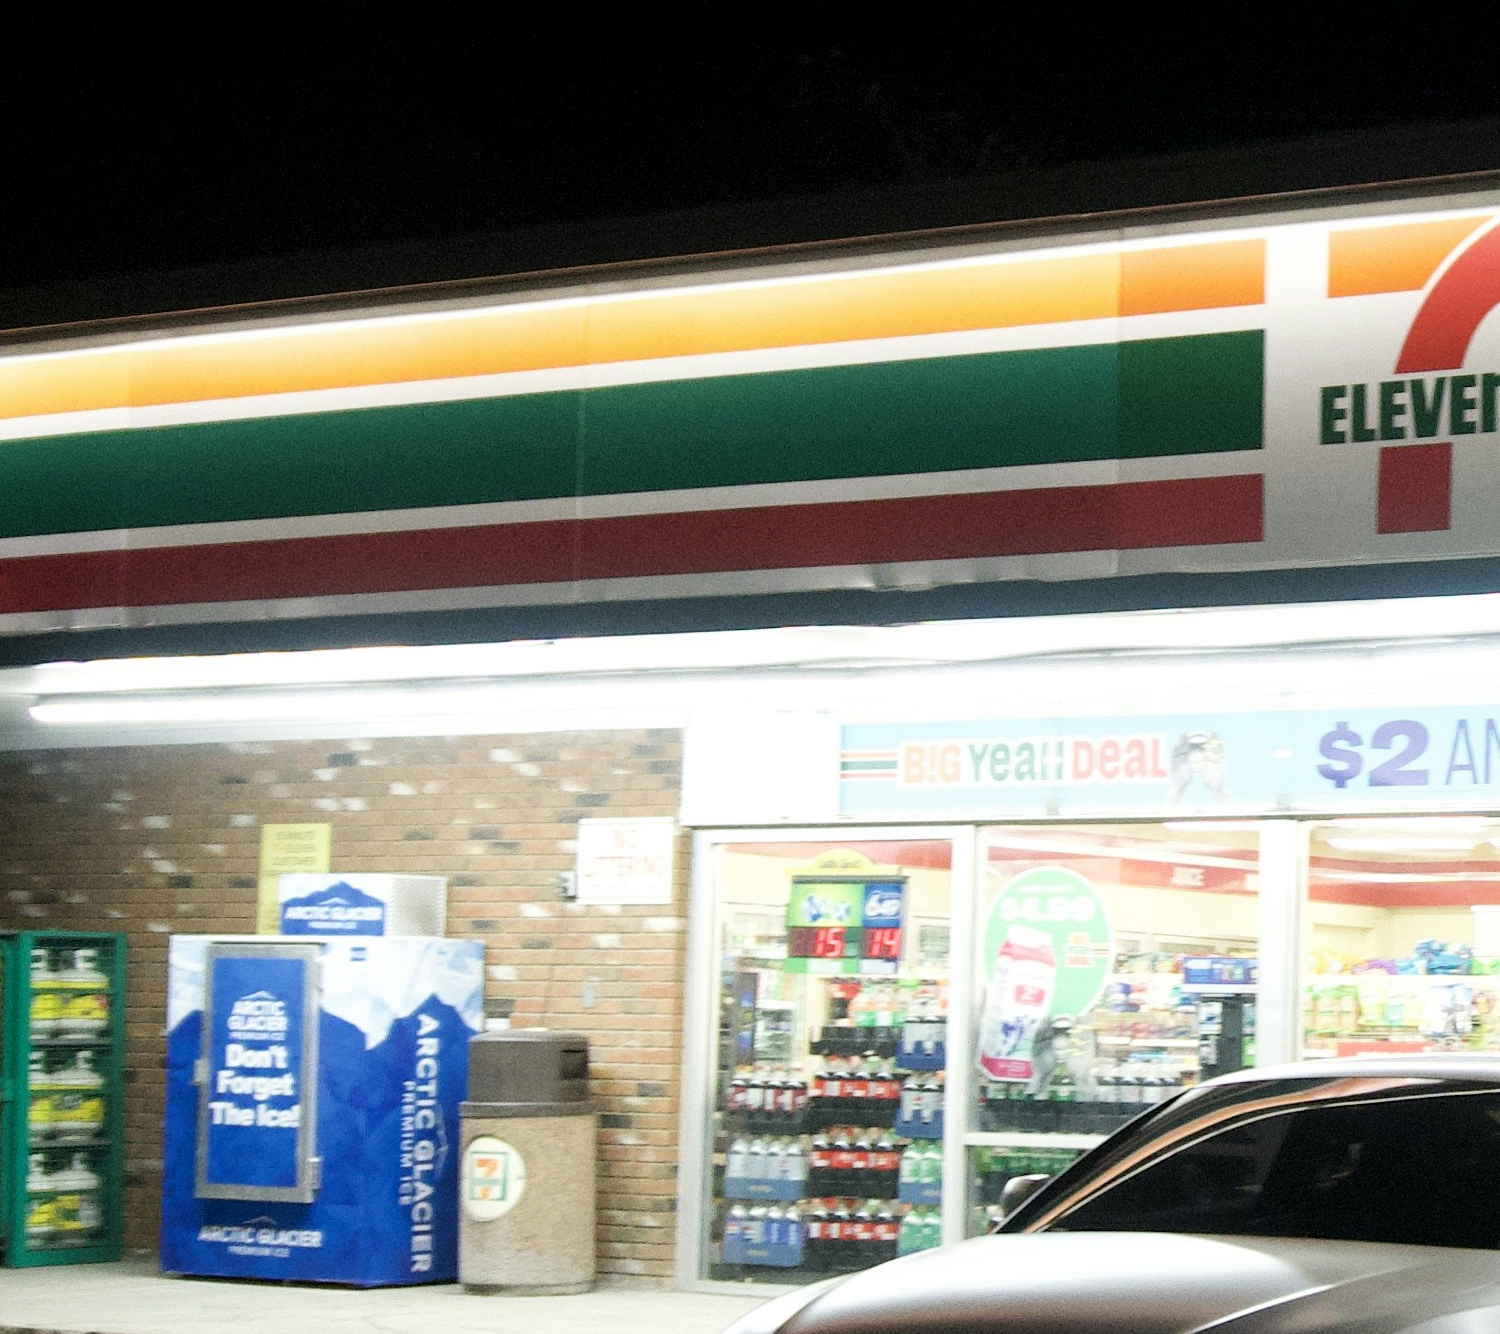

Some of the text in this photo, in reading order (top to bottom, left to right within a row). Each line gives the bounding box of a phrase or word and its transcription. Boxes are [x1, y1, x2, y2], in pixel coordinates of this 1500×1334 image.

[1316, 720, 1431, 789] $2
[814, 927, 845, 958] 15
[870, 928, 903, 957] 14
[224, 1043, 288, 1069] Don't
[216, 1069, 295, 1101] Forget
[207, 1101, 255, 1127] The
[398, 1080, 417, 1206] PREMIUM ICE
[410, 1013, 441, 1273] ARCTIC GLACIER
[197, 1225, 323, 1248] ARCTIC GLACIER
